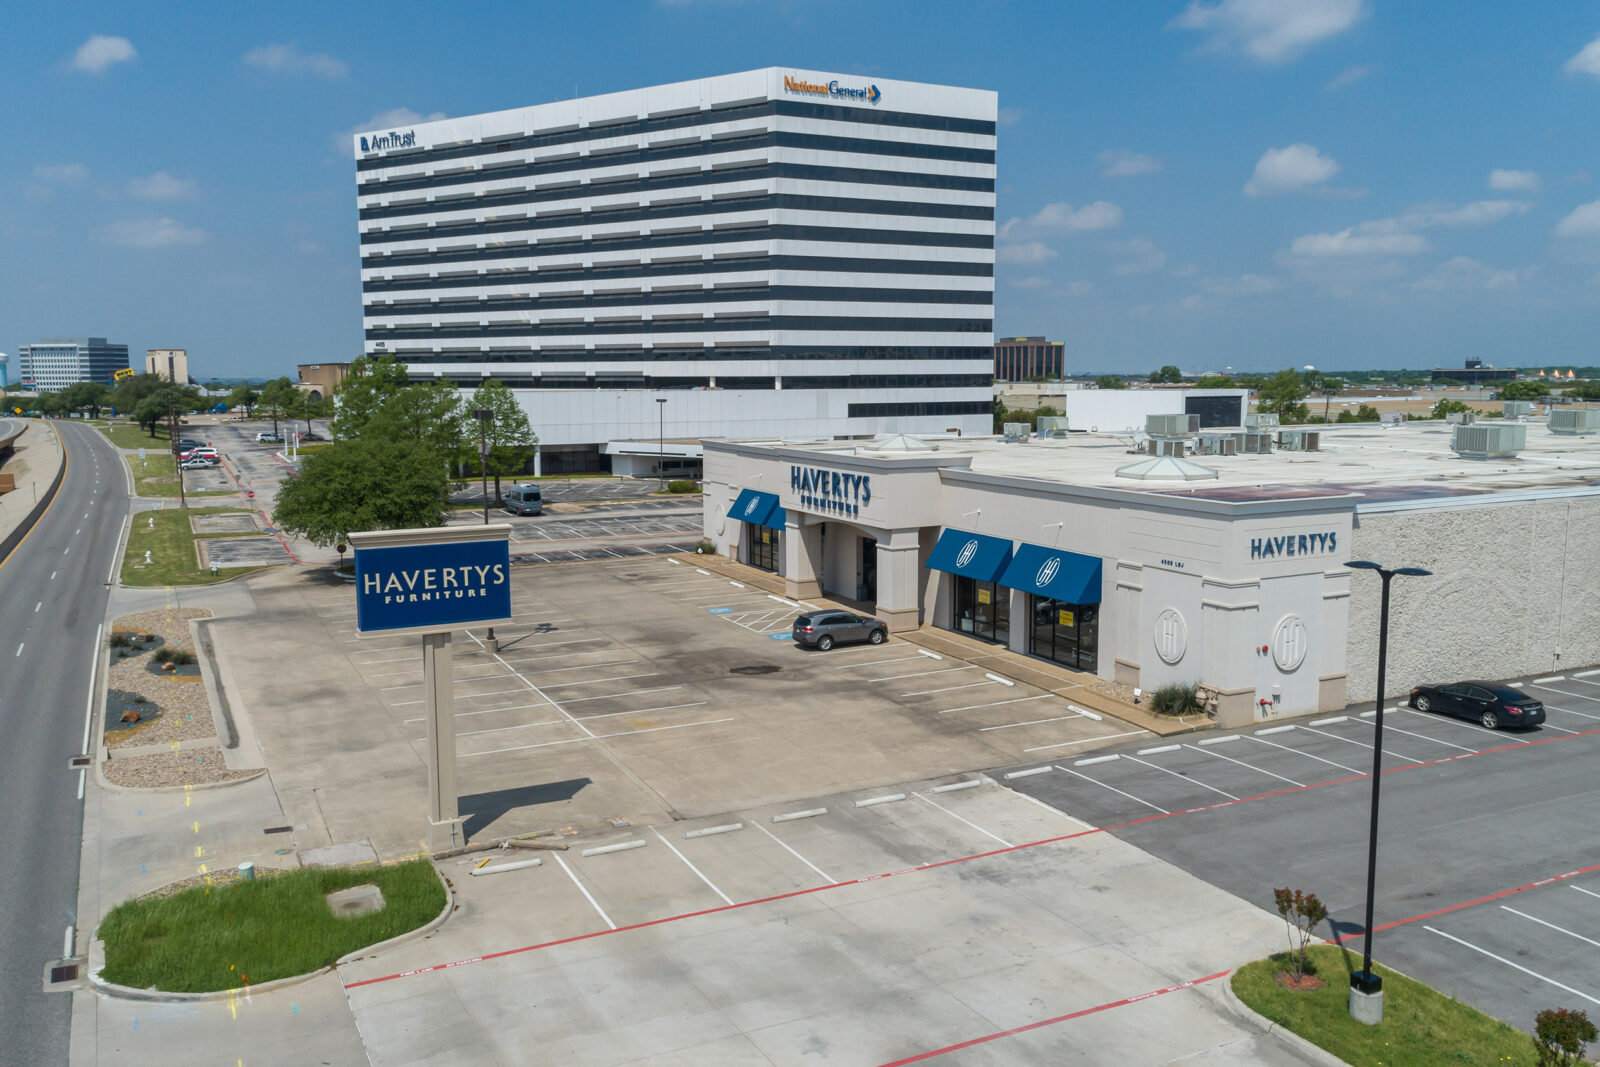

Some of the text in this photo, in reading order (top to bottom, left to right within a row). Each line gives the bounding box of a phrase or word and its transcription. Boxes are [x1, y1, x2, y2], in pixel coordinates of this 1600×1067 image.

[784, 75, 867, 98] National General
[371, 129, 416, 149] AmTrust
[791, 465, 872, 503] HAVERTYS
[801, 495, 859, 515] FURNITURE
[1251, 532, 1337, 559] HAVERTYS
[364, 564, 505, 594] HAVERTYS
[385, 588, 487, 604] FURNITURE
